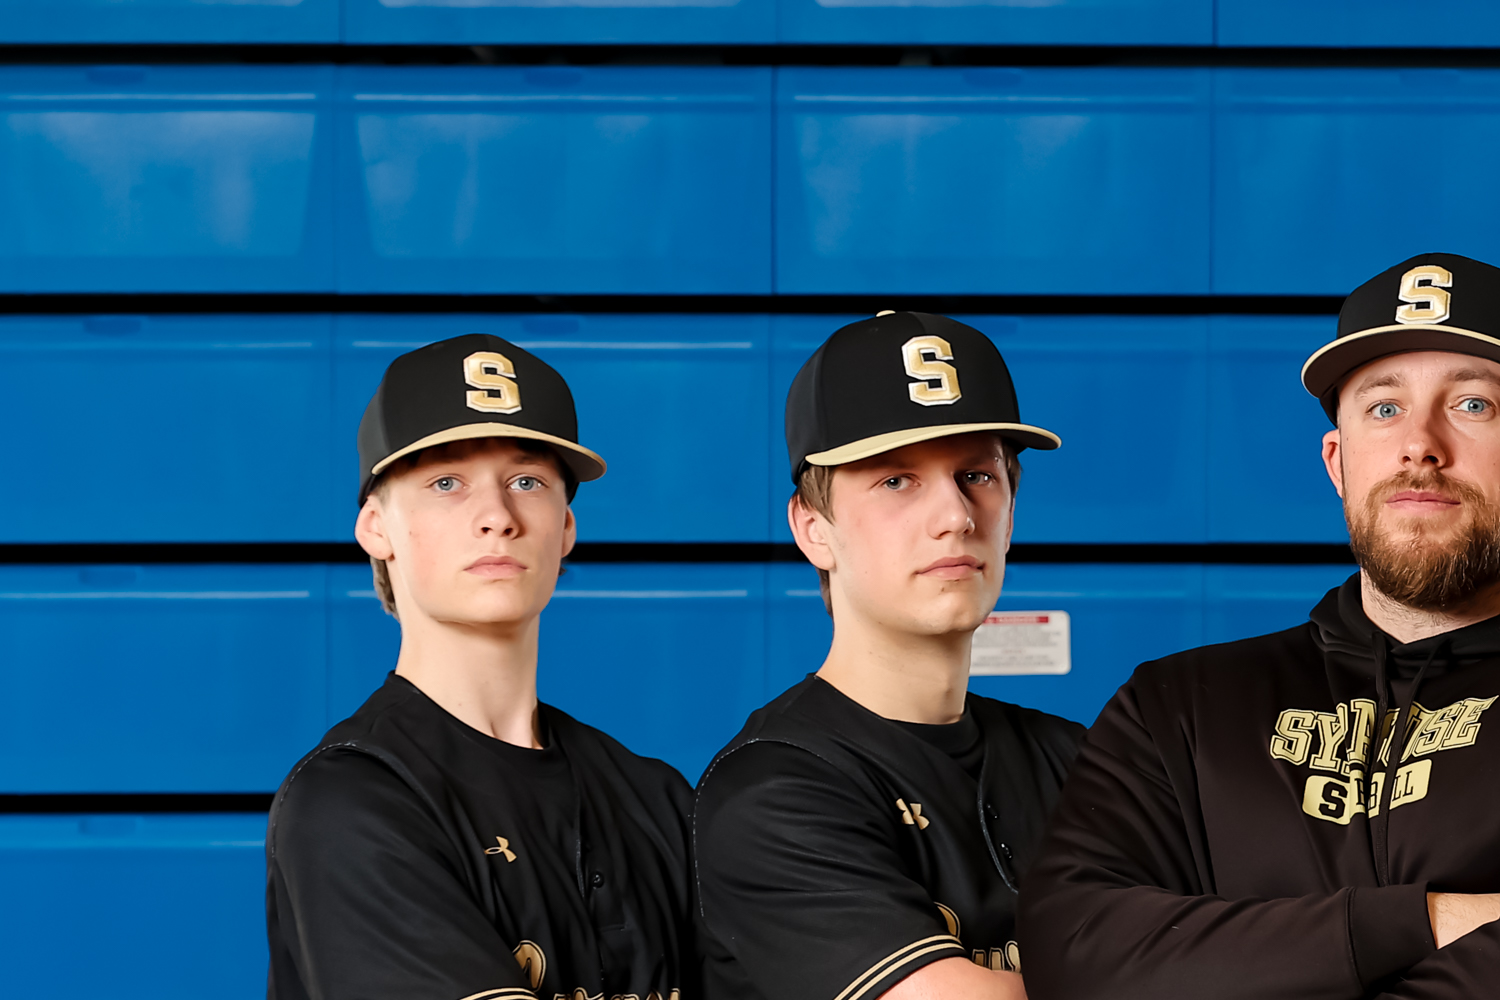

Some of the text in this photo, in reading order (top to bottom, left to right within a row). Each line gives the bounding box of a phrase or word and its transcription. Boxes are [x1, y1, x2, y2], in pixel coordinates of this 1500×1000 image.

[1395, 265, 1453, 325] S
[463, 351, 522, 415] S
[901, 335, 962, 406] S
